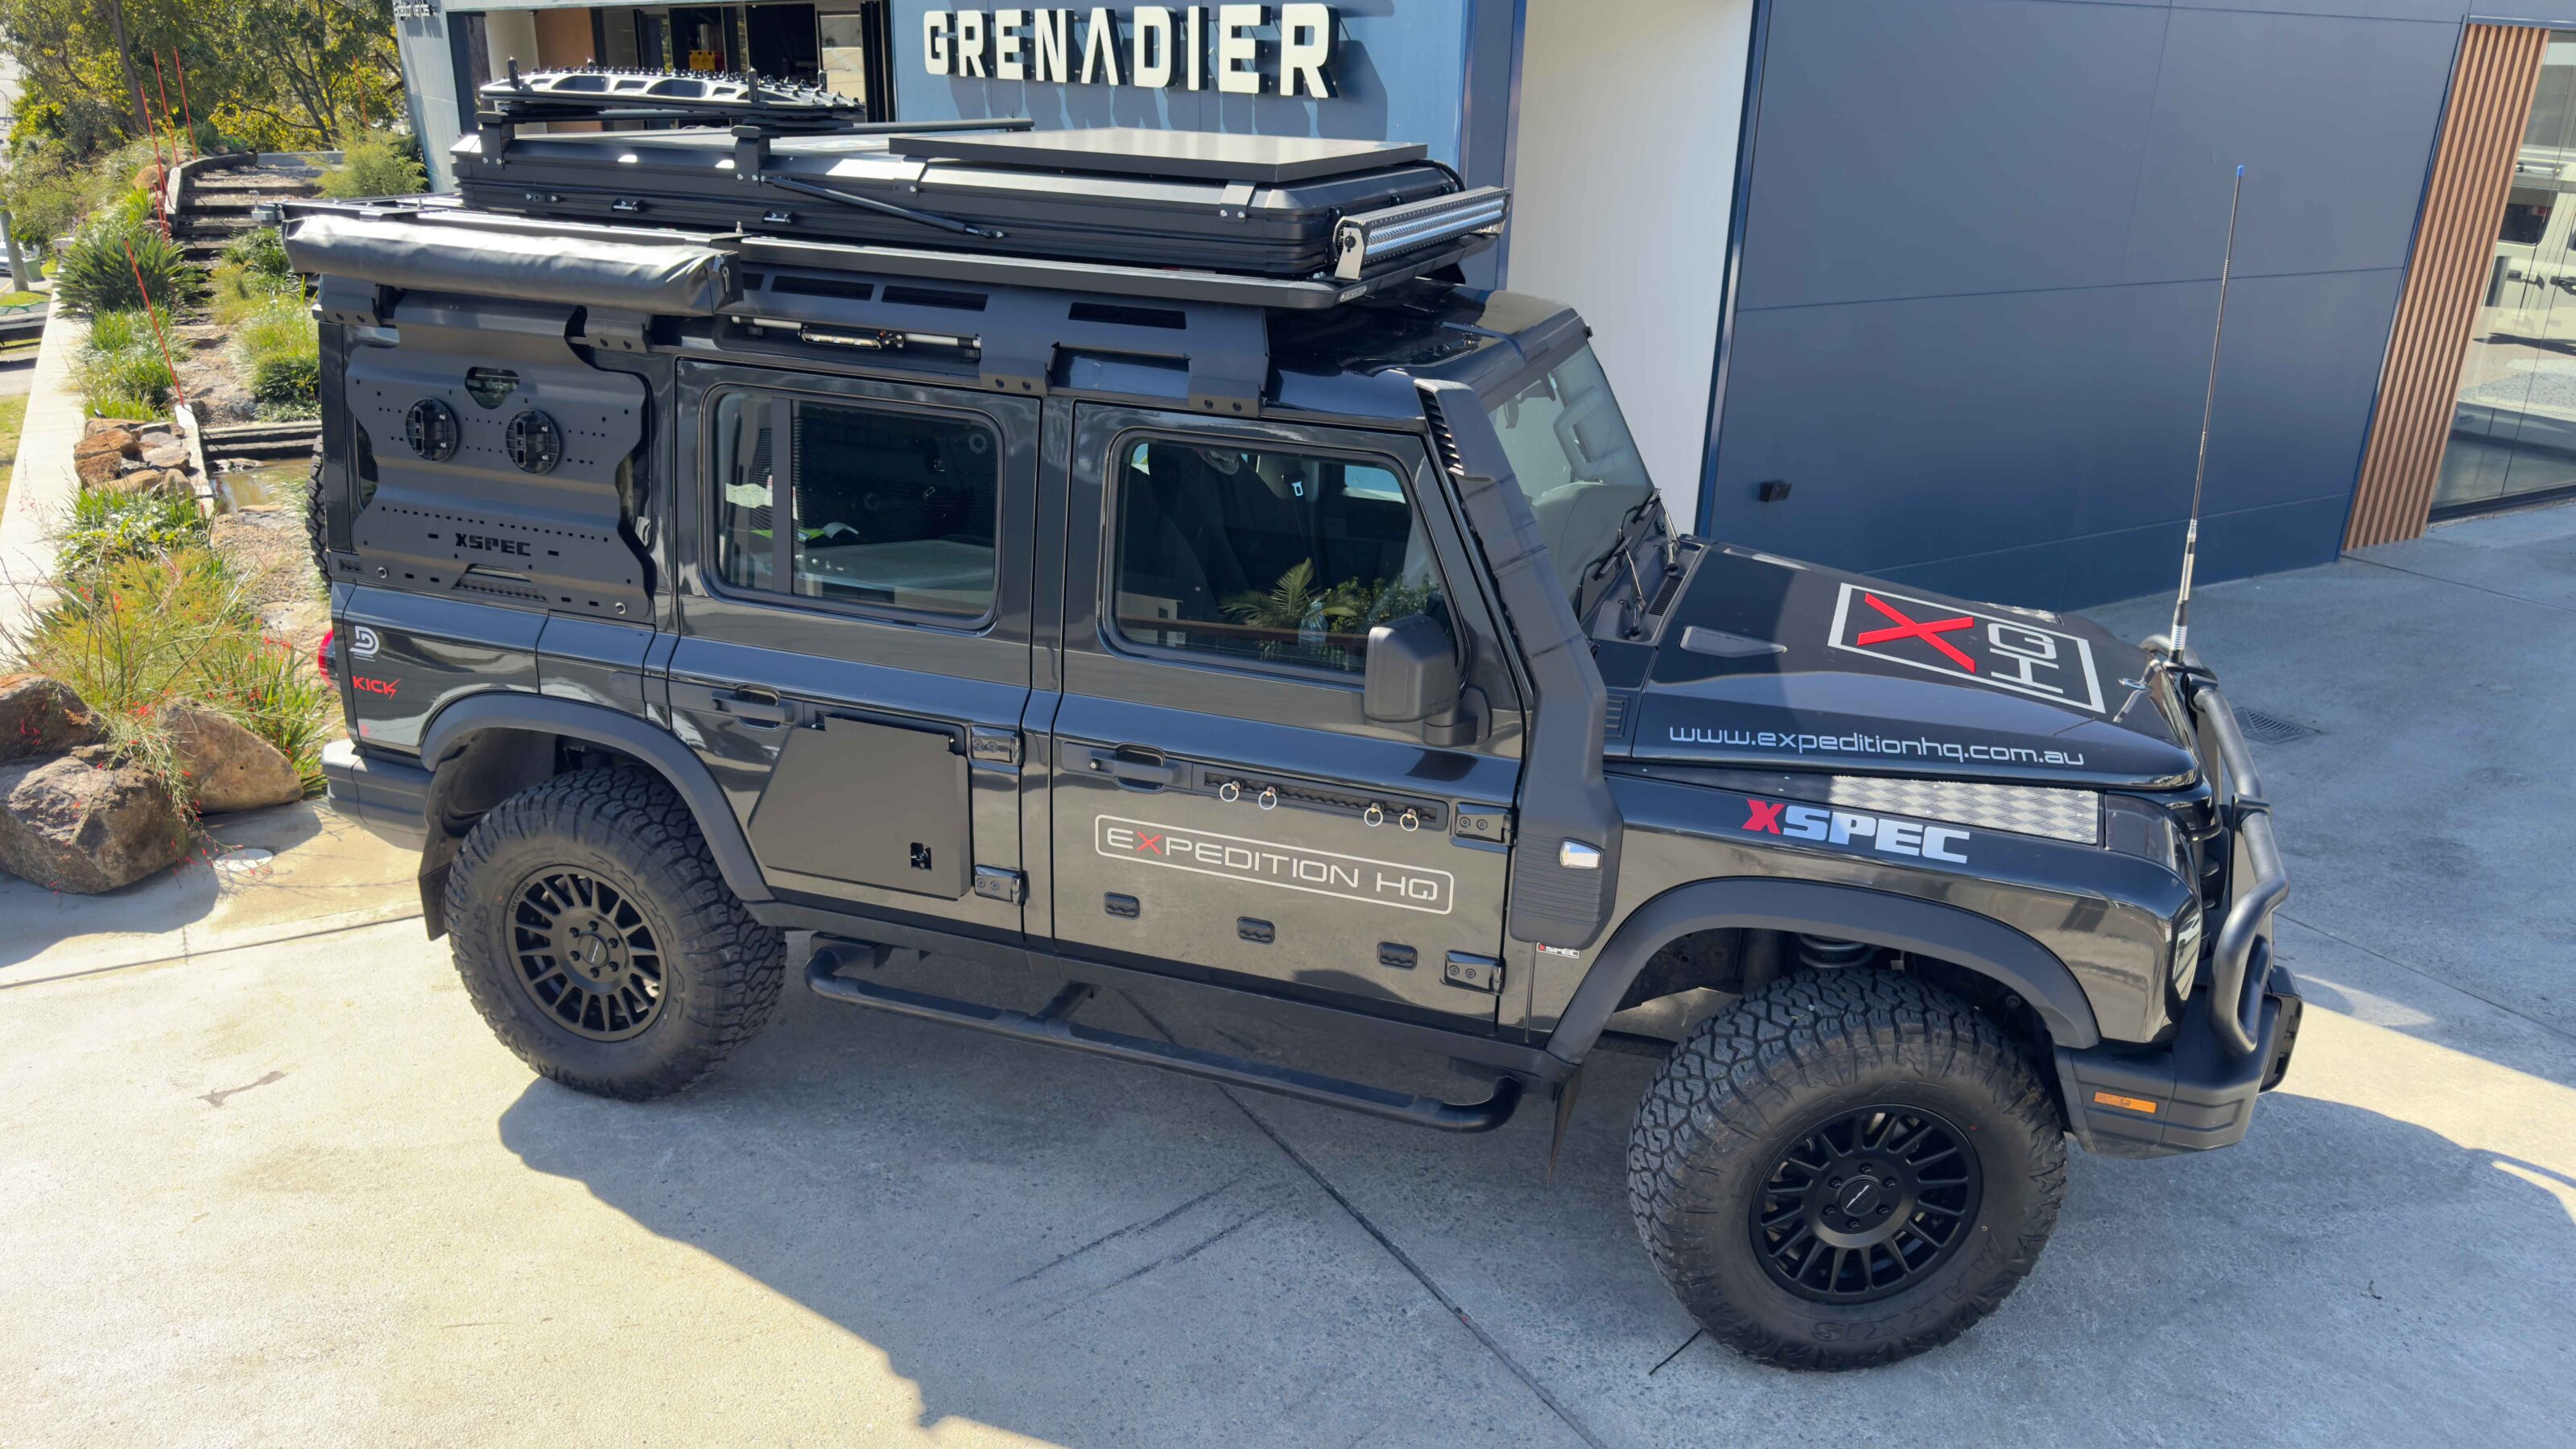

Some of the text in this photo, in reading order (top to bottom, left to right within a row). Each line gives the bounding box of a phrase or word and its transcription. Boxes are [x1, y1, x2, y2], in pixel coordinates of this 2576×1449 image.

[923, 2, 1330, 98] GRENADIER
[455, 533, 531, 556] XSPEC
[352, 676, 401, 700] KICK
[1669, 726, 2084, 766] www.expeditionhq.com.au
[1741, 799, 1971, 864] XSPEC
[1107, 827, 1439, 902] EXPEDITION HQ
